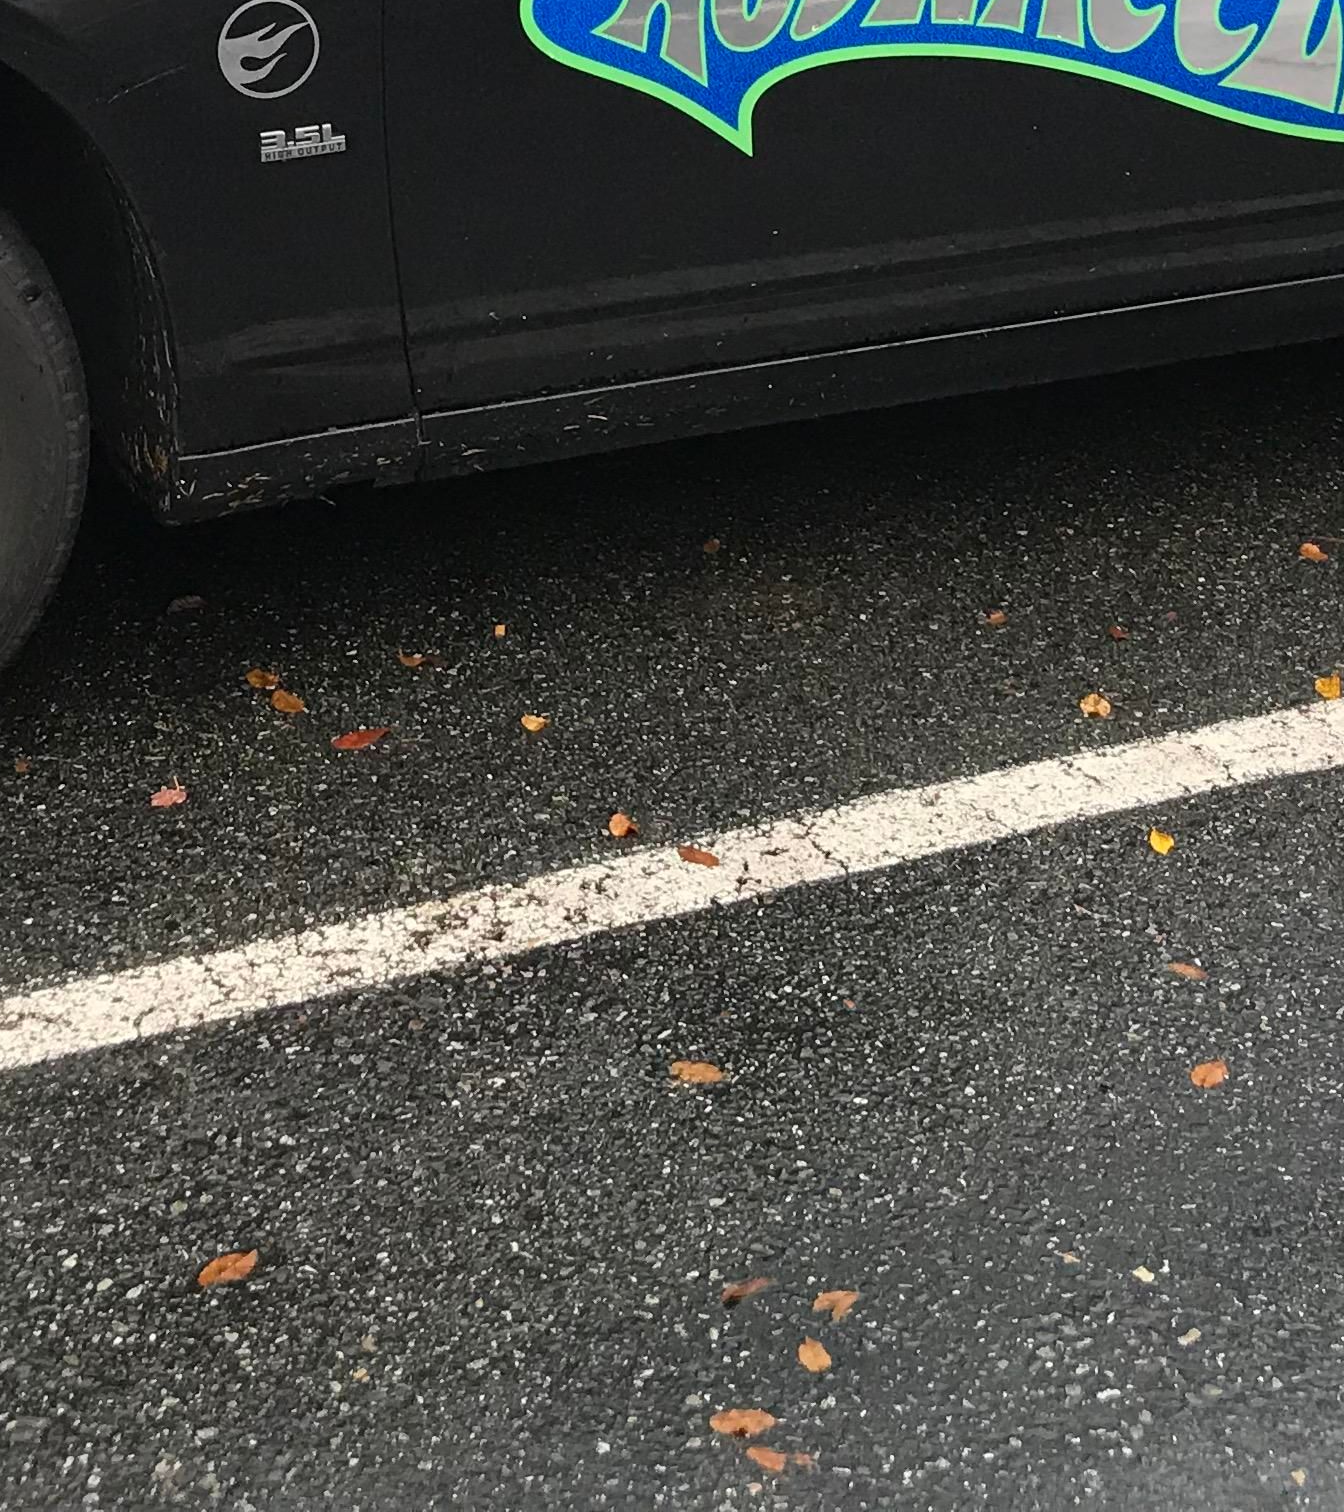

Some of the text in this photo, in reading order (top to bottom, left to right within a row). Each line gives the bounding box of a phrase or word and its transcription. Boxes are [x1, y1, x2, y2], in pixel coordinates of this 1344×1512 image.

[259, 123, 346, 151] 3.5L
[264, 141, 344, 162] HIGH OUTPUT
